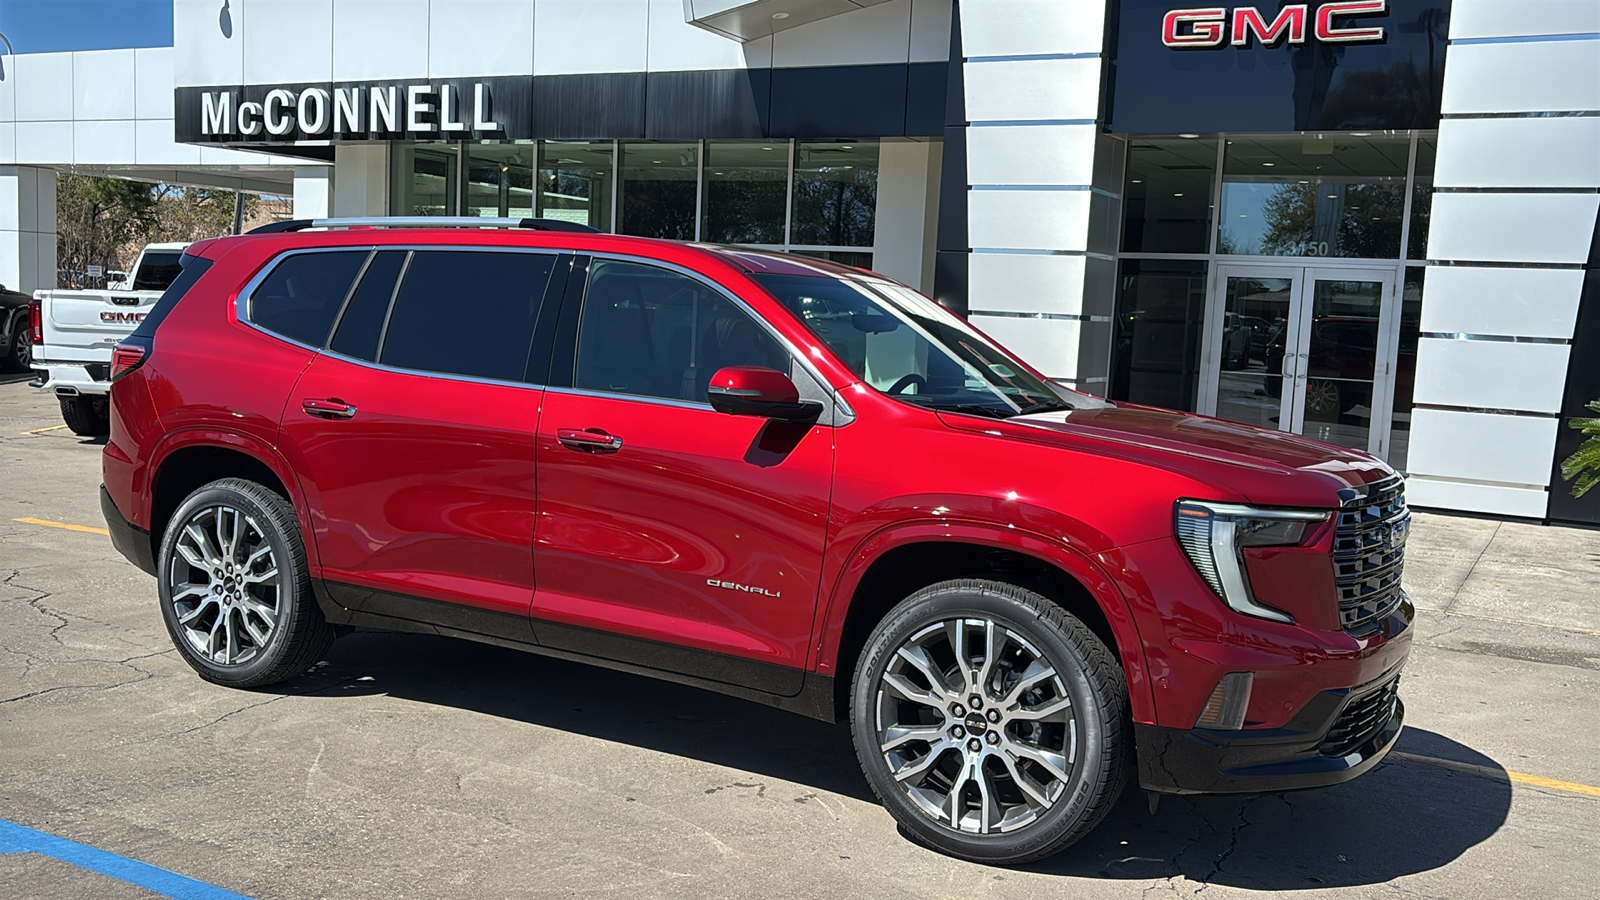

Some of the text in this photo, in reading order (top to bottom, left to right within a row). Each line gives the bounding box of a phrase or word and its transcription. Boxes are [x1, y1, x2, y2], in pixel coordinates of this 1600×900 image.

[1162, 0, 1385, 47] GMC
[201, 83, 498, 135] McCONNELL
[706, 579, 781, 598] DENALI
